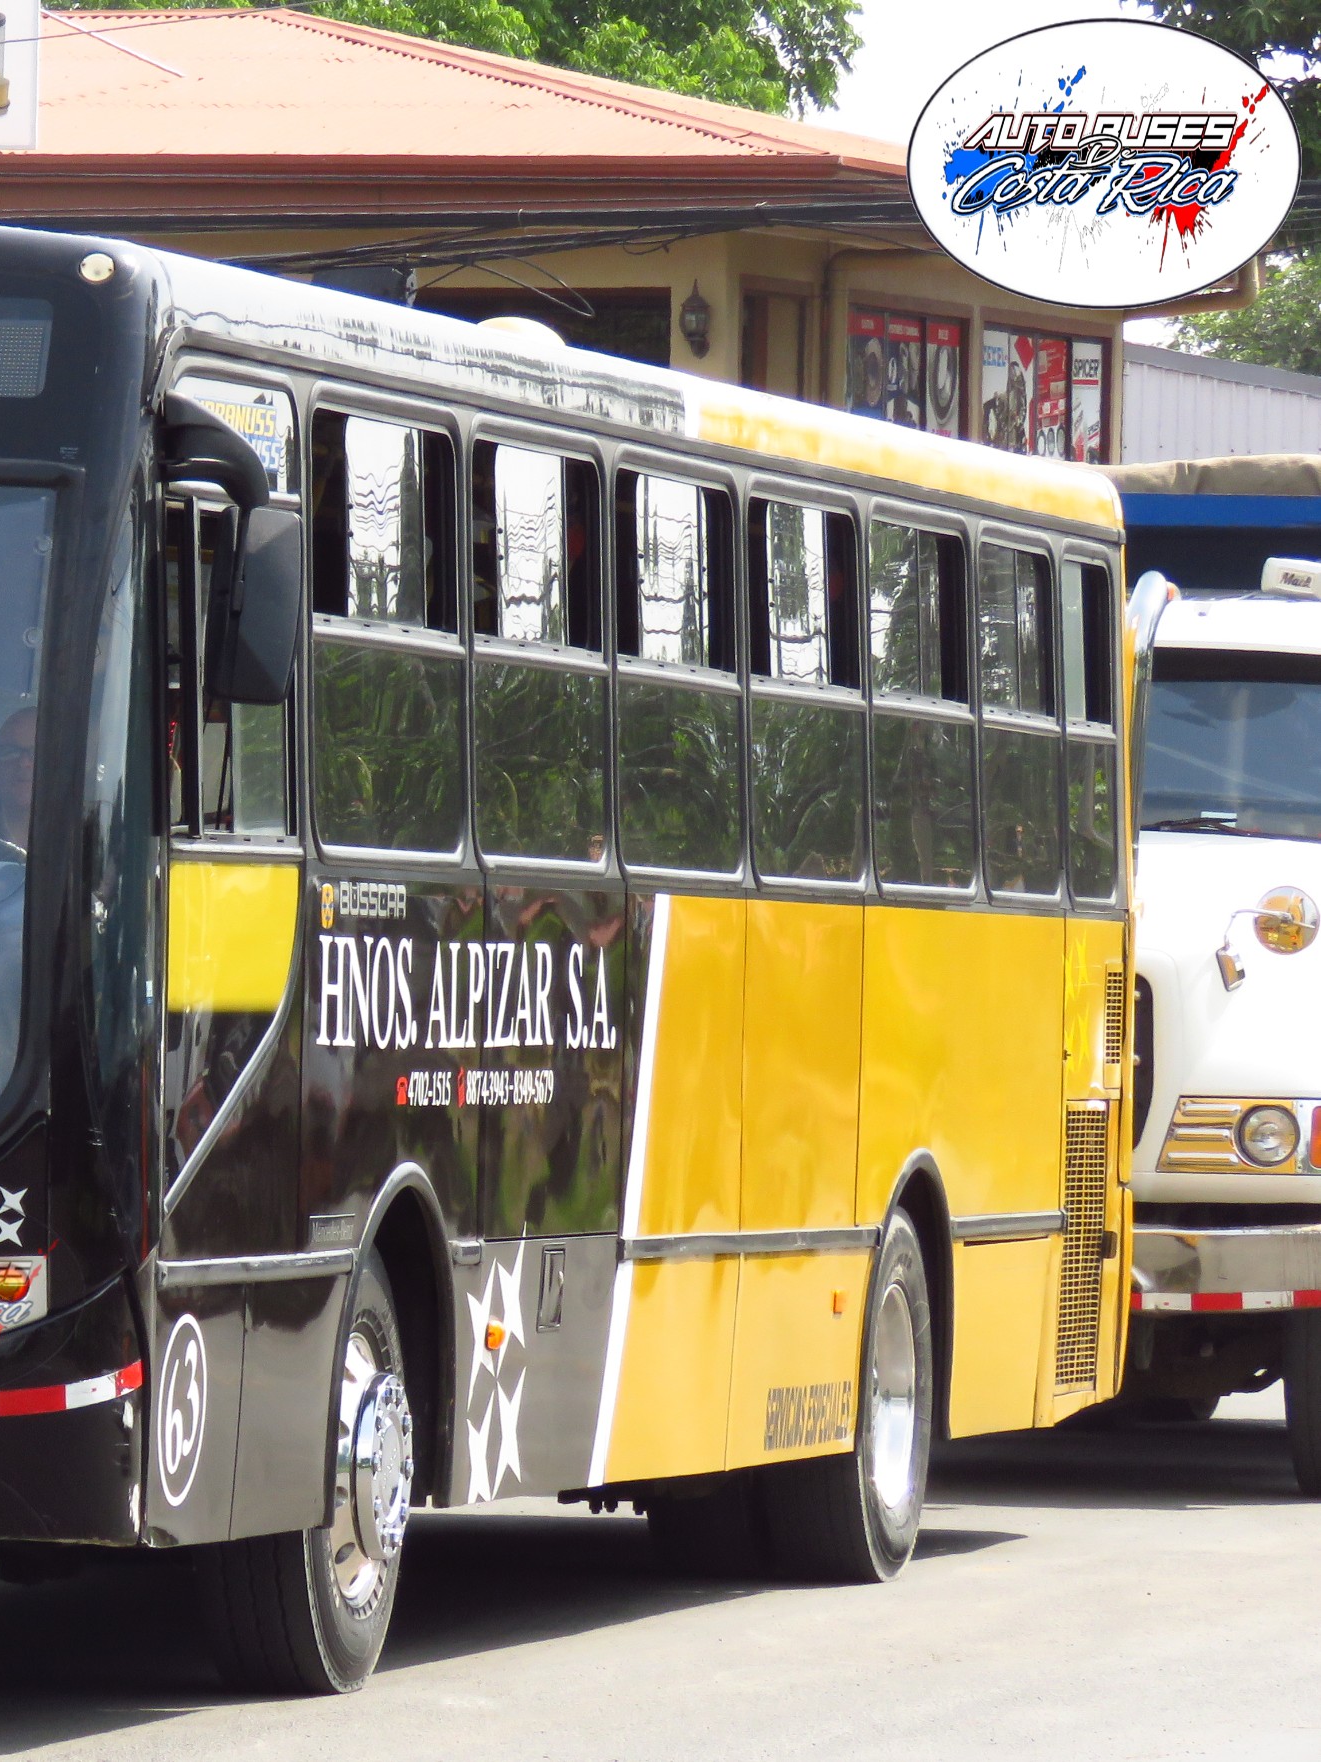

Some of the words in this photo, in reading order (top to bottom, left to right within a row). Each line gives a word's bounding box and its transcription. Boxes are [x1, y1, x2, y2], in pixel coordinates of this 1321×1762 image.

[339, 881, 407, 919] BUSSCAR
[315, 934, 418, 1051] HNOS.
[424, 940, 554, 1050] ALPIZAR
[565, 942, 617, 1051] S.A.
[164, 1339, 200, 1475] 63
